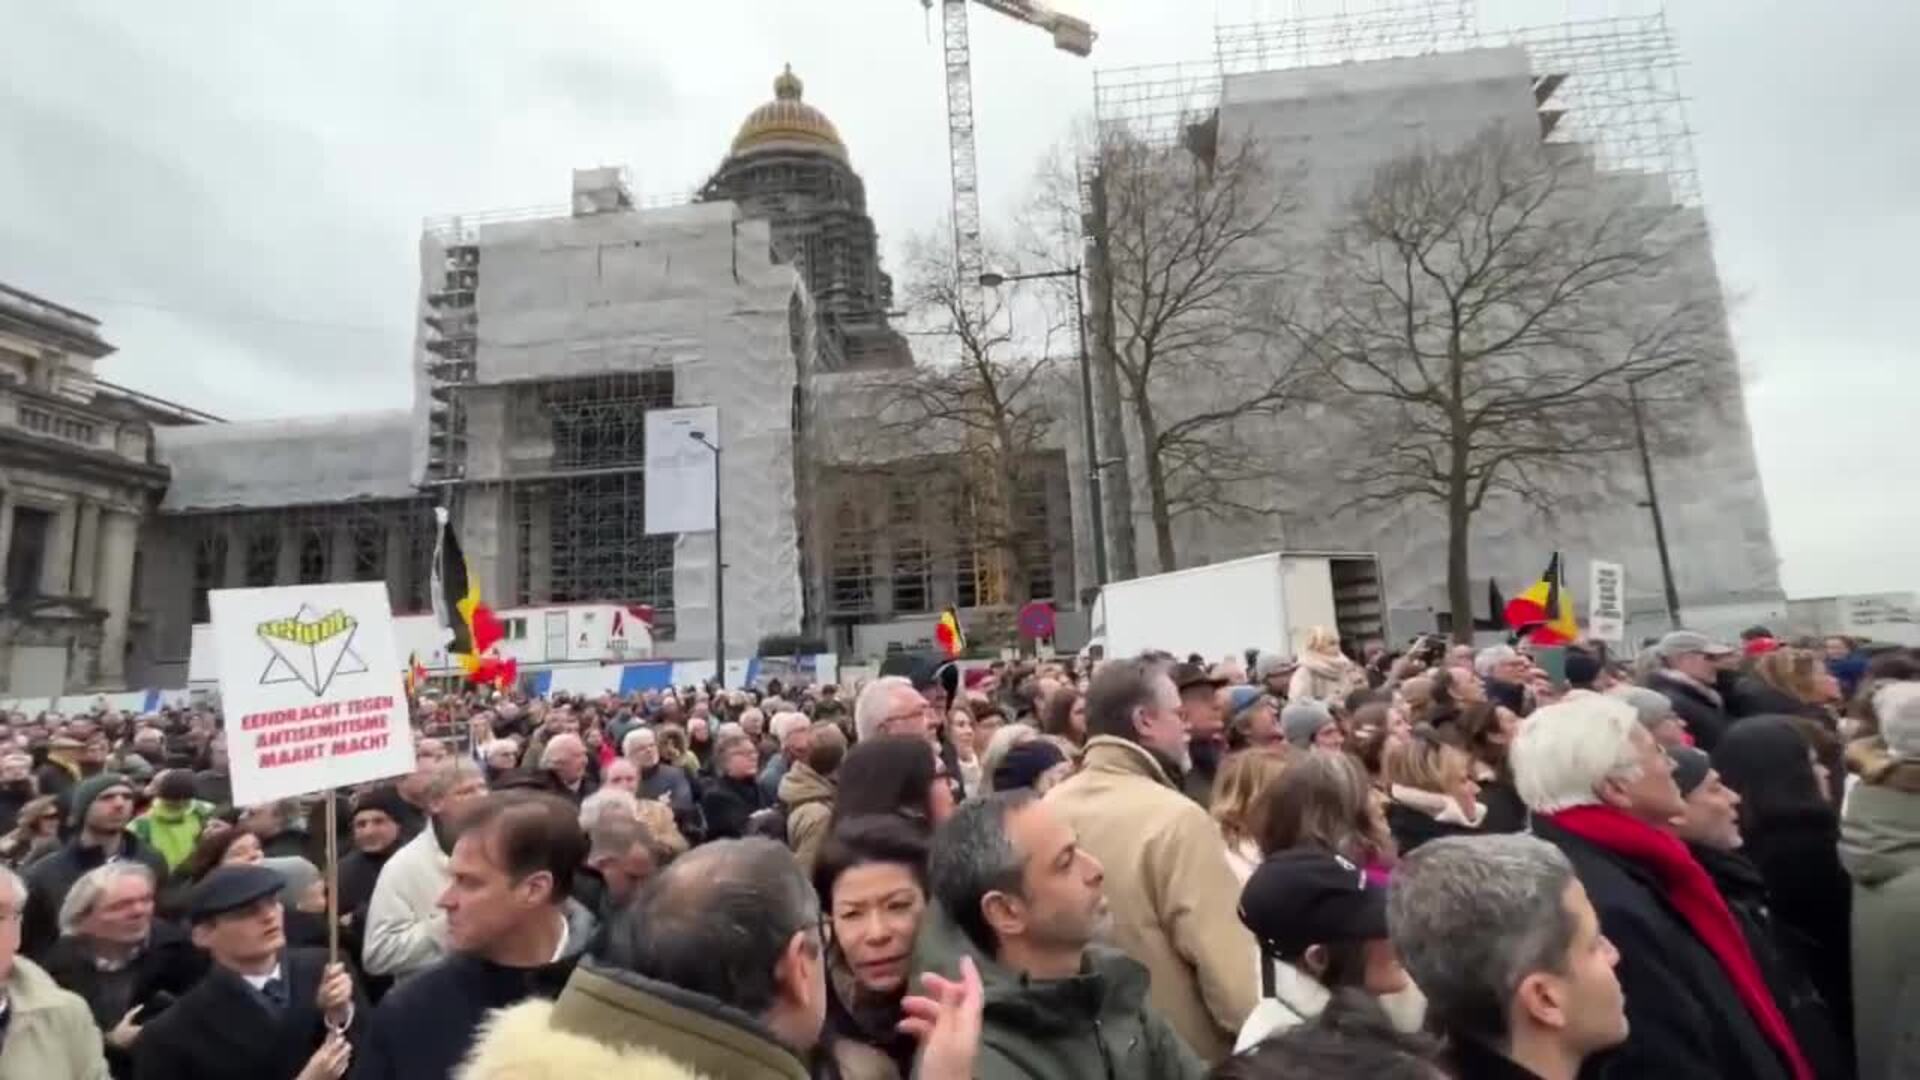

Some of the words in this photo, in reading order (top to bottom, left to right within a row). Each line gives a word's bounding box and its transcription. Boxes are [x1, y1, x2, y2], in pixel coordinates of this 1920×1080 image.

[242, 703, 340, 730] EENDRACHT
[348, 696, 394, 715] TEGEN
[256, 715, 388, 748] ANTISEMITISME
[259, 744, 325, 768] MAAKT
[332, 733, 389, 756] MACHT
